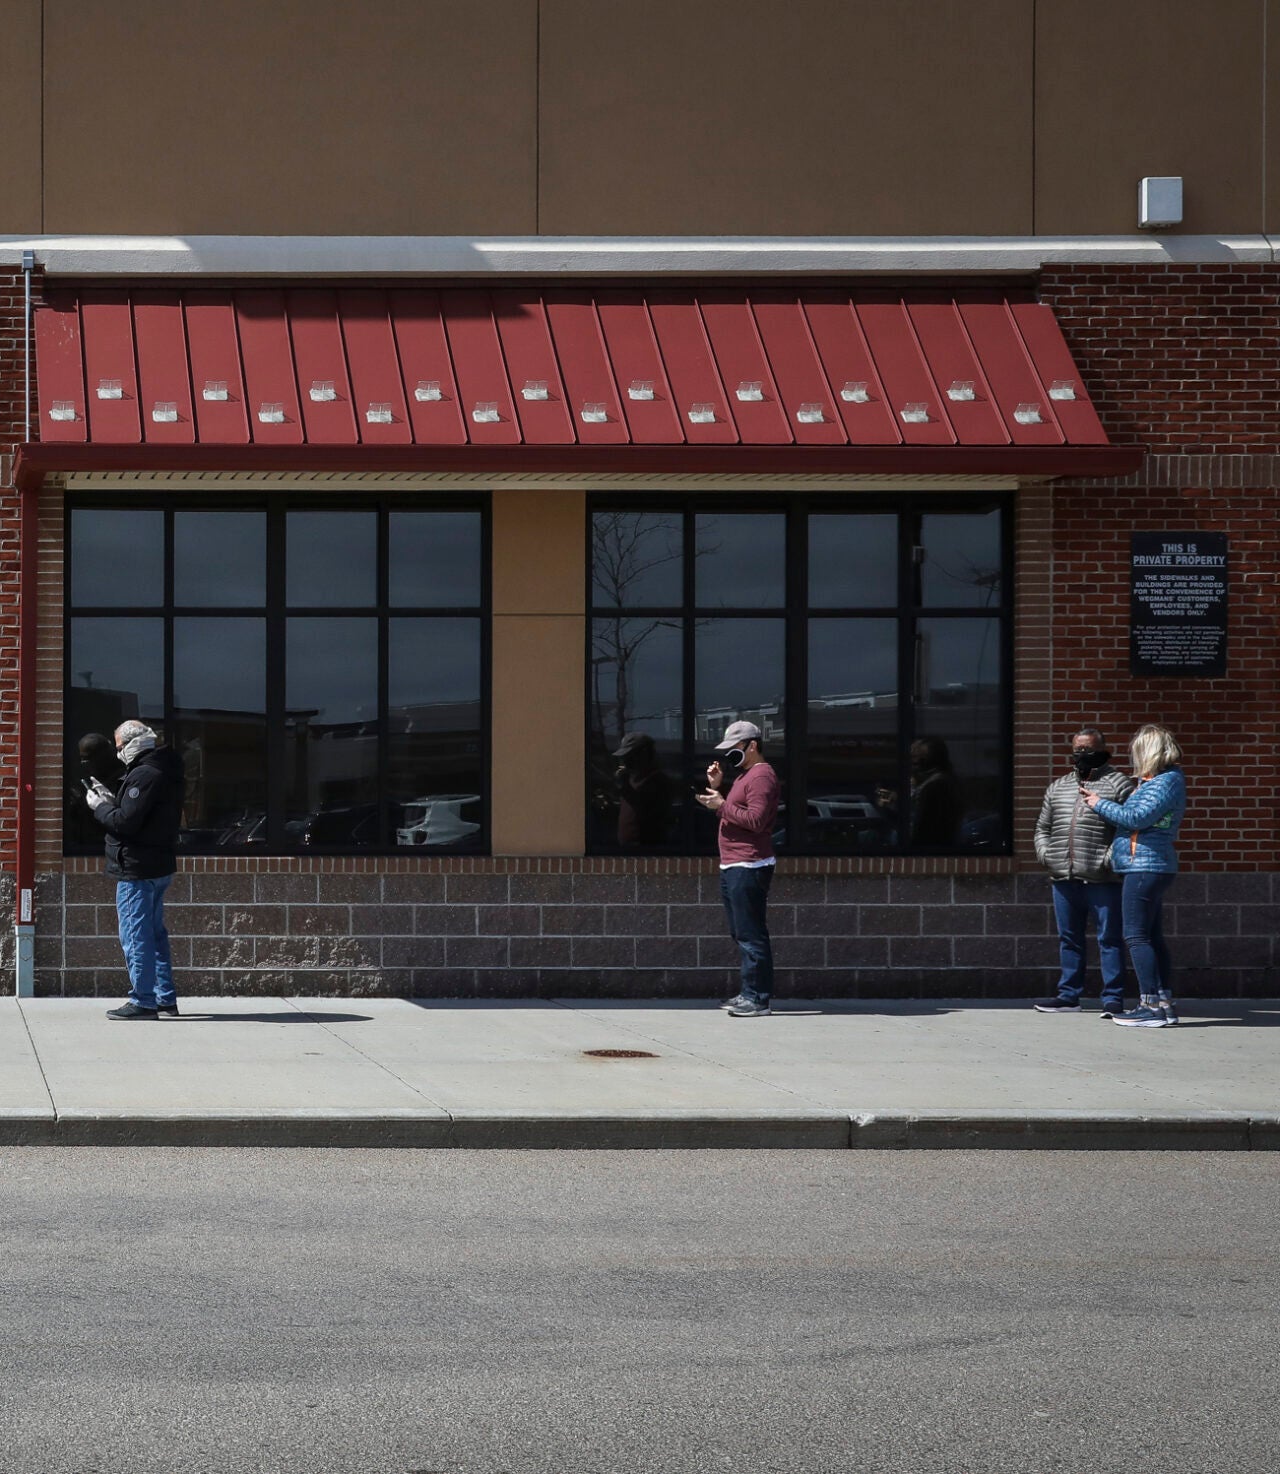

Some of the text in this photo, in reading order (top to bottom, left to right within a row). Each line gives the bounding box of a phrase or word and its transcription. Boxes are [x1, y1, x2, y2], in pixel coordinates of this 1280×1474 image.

[1162, 543, 1197, 553] THIS IS
[1133, 555, 1225, 565] PRIVATE PROPERTY
